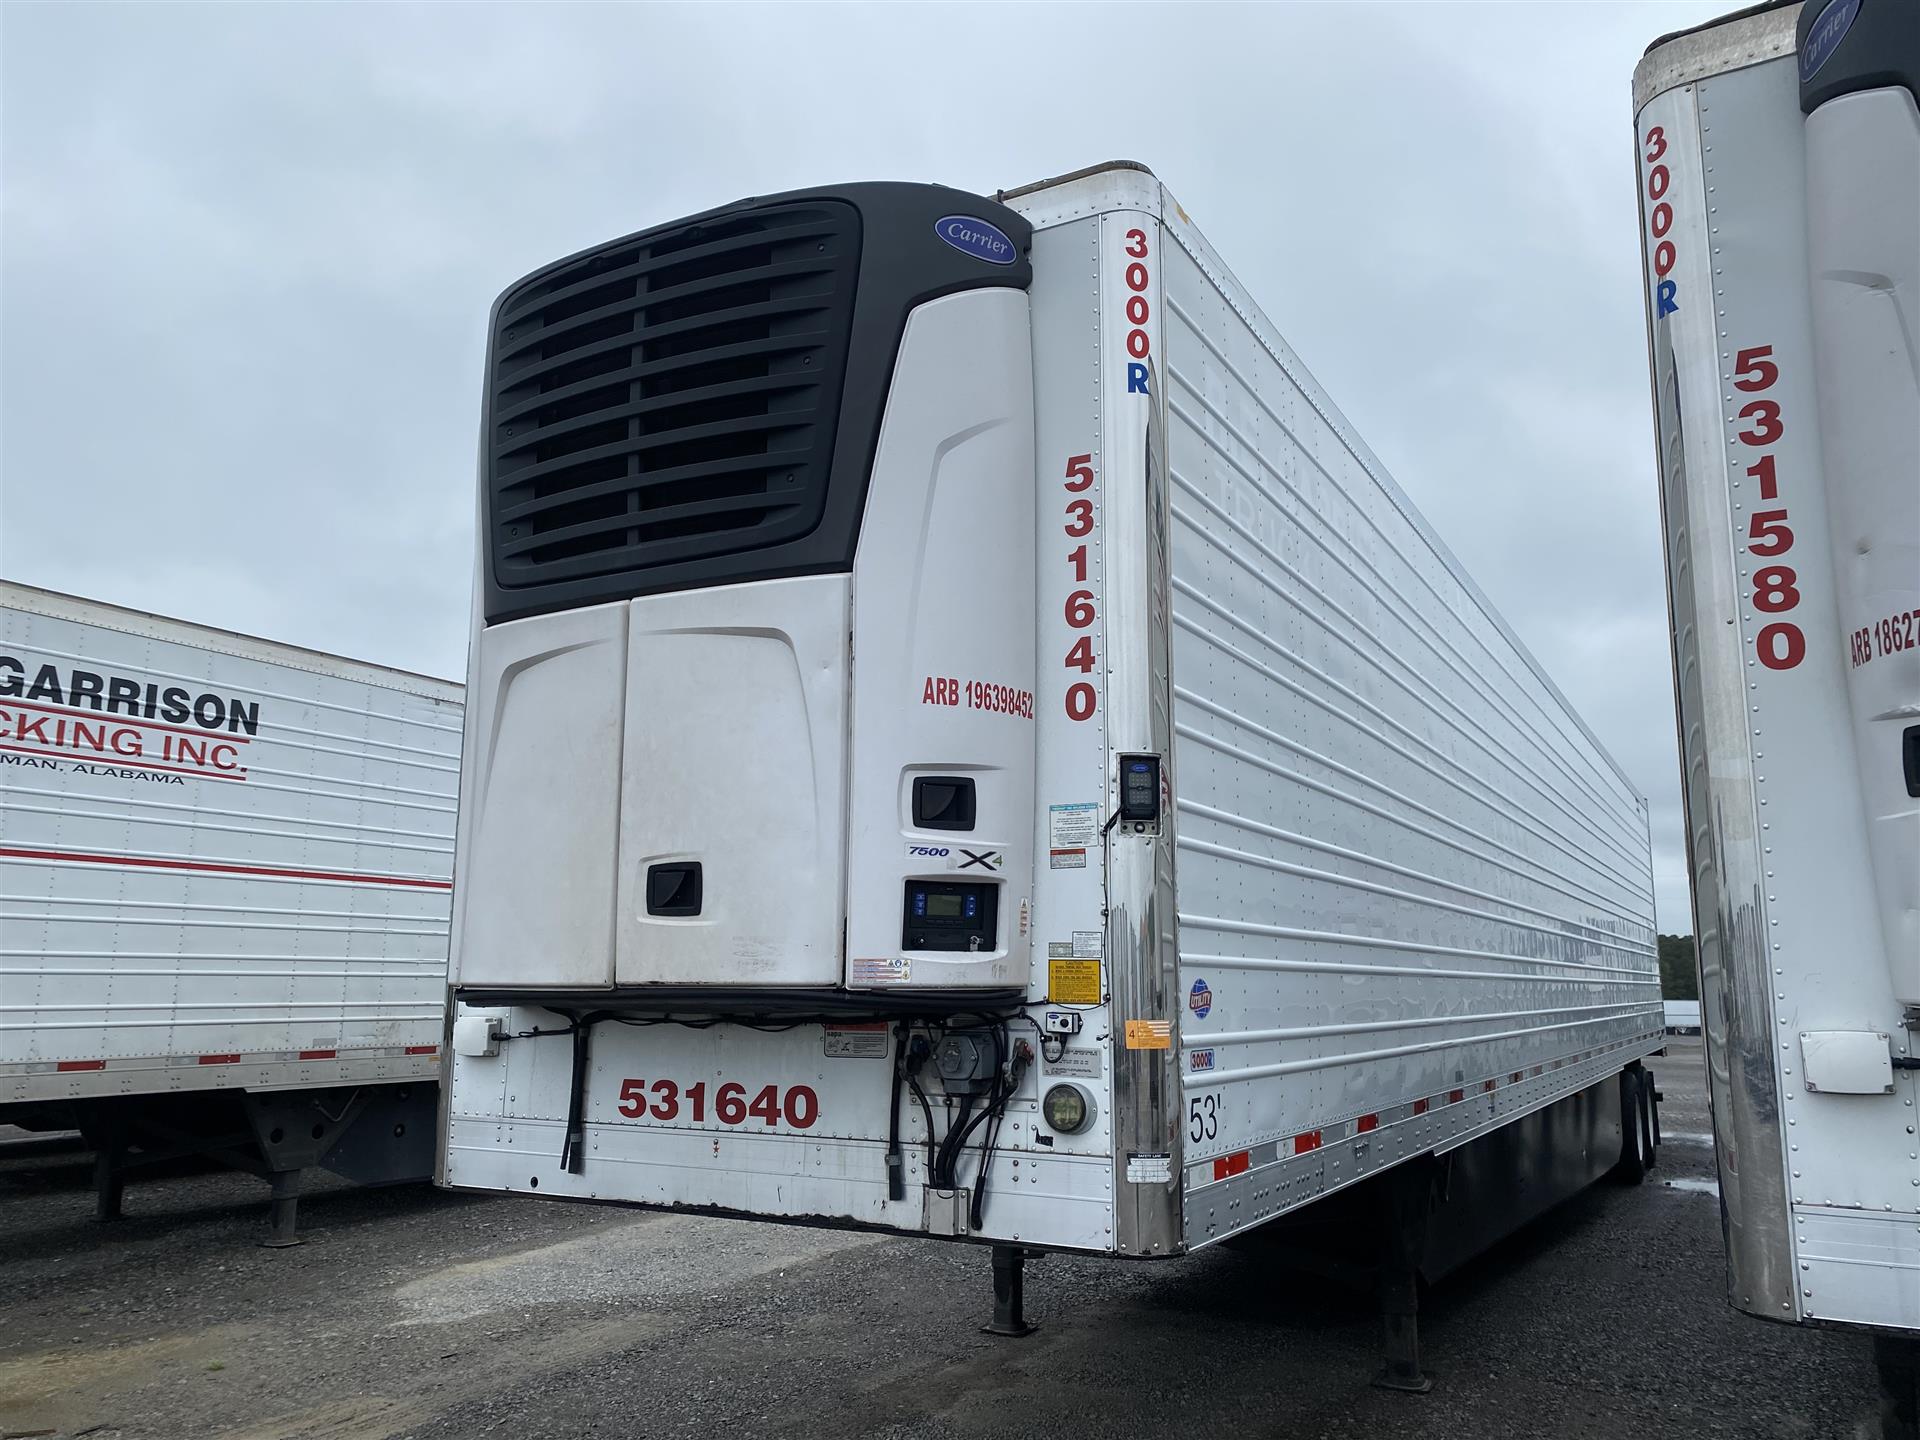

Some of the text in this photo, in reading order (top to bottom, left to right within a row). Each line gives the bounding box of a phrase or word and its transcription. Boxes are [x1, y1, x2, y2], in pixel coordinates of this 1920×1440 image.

[1804, 4, 1848, 70] Carrier
[947, 223, 1008, 255] Carrier
[1125, 228, 1150, 395] 3000R
[1734, 345, 1806, 670] 531580
[1064, 454, 1096, 721] 531640
[1850, 626, 1872, 670] ARB
[0, 655, 260, 737] GARRISON
[922, 676, 1034, 720] ARB 196398452
[72, 763, 185, 786] ALABAMA
[162, 734, 248, 774] INC.
[909, 846, 950, 857] 7500
[1190, 991, 1212, 1009] UTILITY
[1128, 1029, 1135, 1039] 4
[1191, 1051, 1213, 1070] 3000R
[618, 1078, 819, 1129] 531640
[1190, 1093, 1221, 1144] 53'
